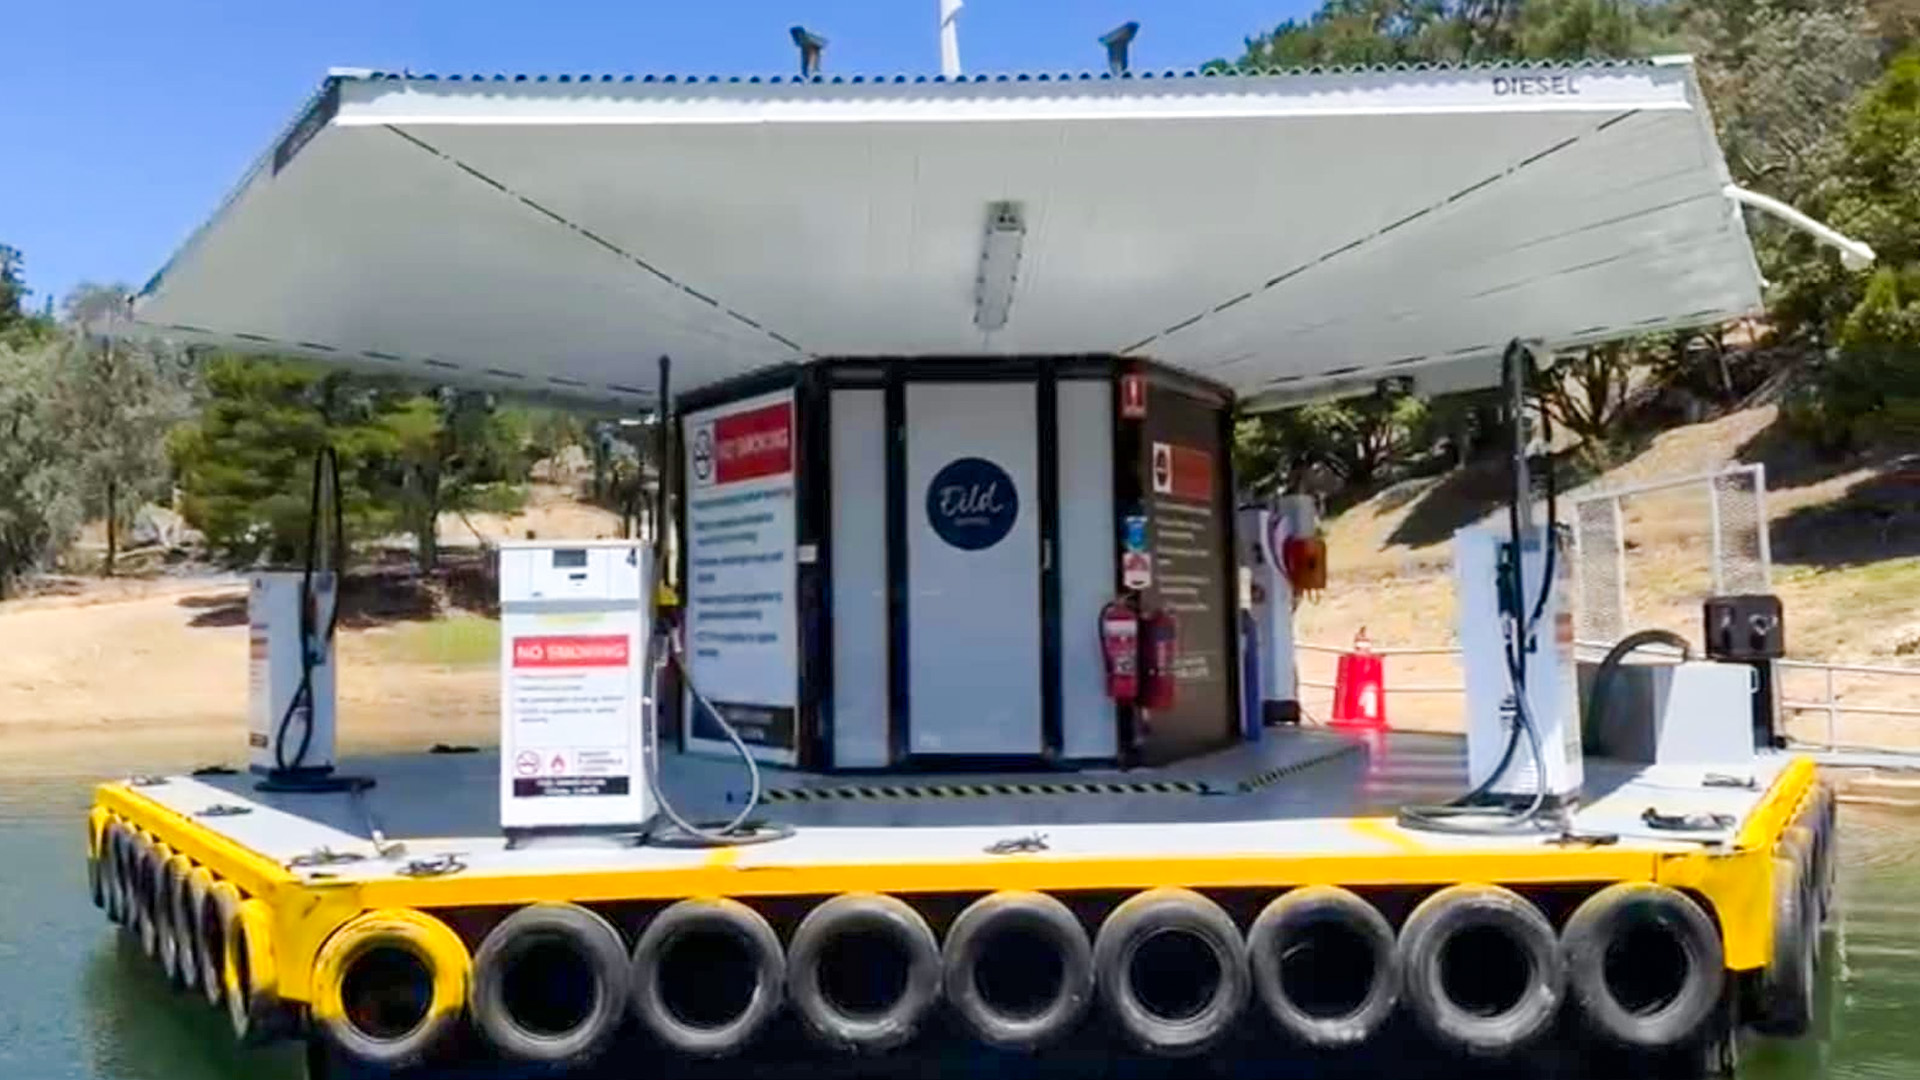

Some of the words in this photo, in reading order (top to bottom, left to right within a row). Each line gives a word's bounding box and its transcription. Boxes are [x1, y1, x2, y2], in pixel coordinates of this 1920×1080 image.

[1492, 76, 1580, 96] DIESEL
[625, 547, 638, 568] 4
[516, 645, 544, 661] NO
[546, 642, 627, 661] SMOKING
